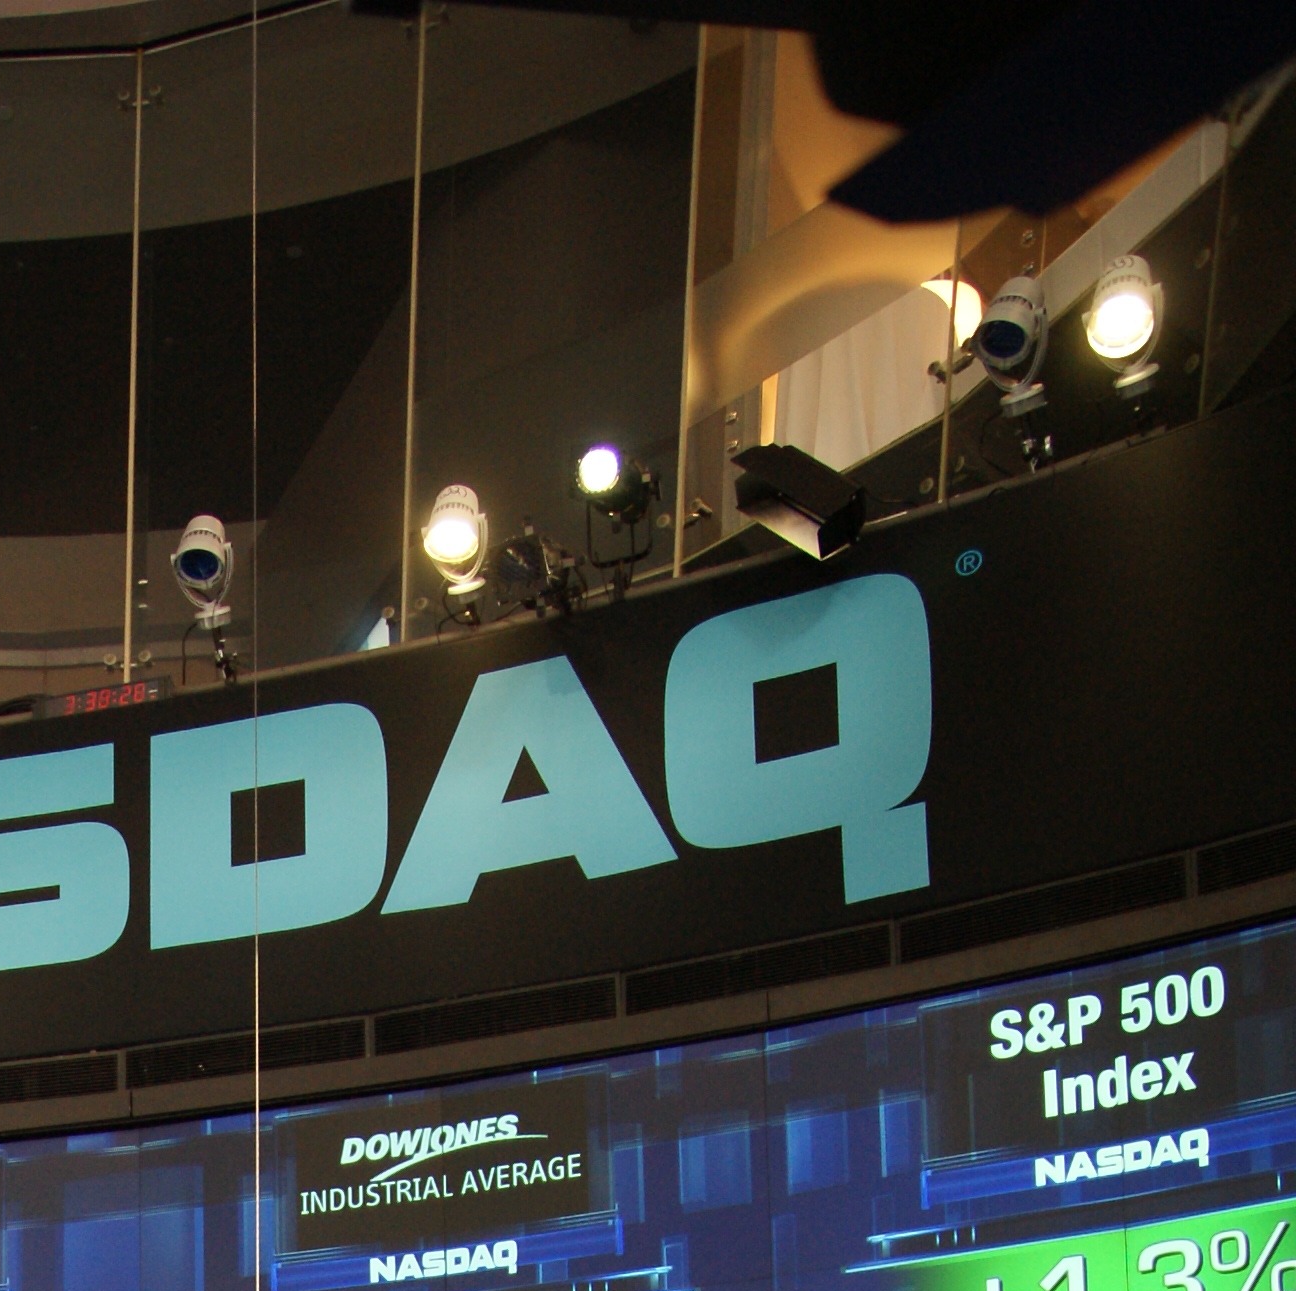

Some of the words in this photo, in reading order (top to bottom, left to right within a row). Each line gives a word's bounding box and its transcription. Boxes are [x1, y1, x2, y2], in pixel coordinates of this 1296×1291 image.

[990, 995, 1101, 1059] S&P
[1121, 966, 1225, 1034] 500
[1043, 1053, 1197, 1117] Index
[301, 1174, 454, 1215] INDUSTRIAL
[462, 1154, 582, 1195] AVERAGE
[1035, 1128, 1209, 1186] NASDAQ
[370, 1240, 518, 1283] NASDAQ
